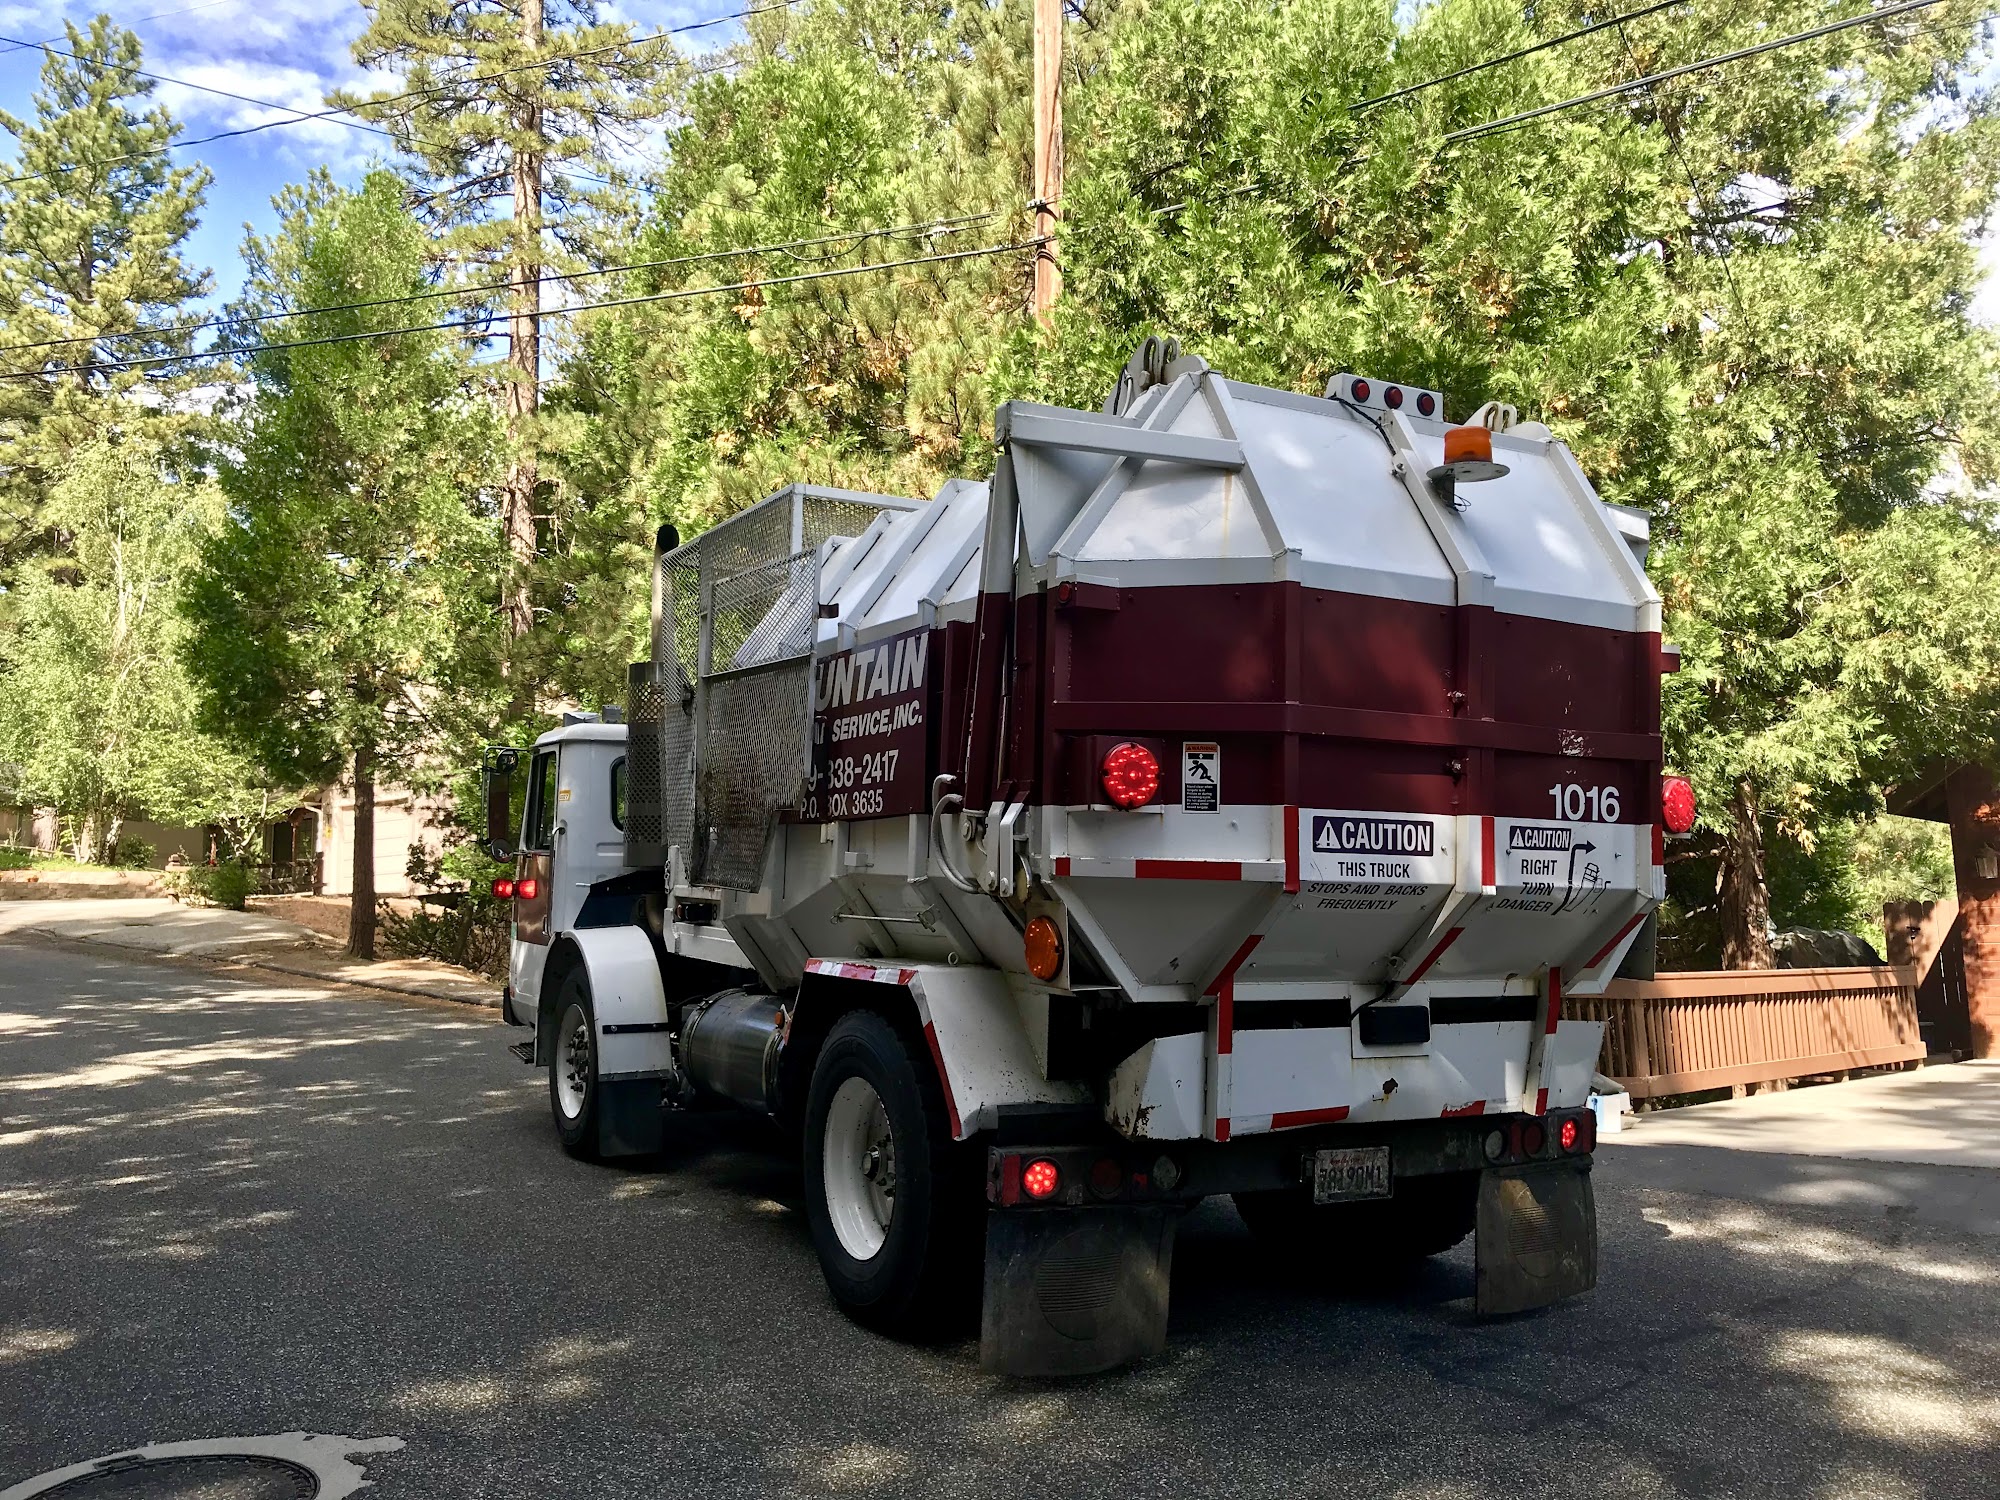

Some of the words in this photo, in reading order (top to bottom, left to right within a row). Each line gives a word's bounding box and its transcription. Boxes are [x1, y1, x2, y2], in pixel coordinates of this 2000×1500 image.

[815, 632, 929, 712] UNTAIN
[852, 788, 883, 815] 3635
[1548, 783, 1620, 823] 1016
[1341, 821, 1431, 852] CAUTION
[1524, 828, 1570, 849] CAUTION
[1338, 861, 1366, 877] THIS
[1369, 862, 1410, 878] TRUCK
[1521, 858, 1557, 875] RIGHT
[1307, 882, 1352, 894] STOPS
[1350, 884, 1380, 895] AND
[1384, 885, 1428, 896] BACKS
[1519, 881, 1555, 896] TURN
[1317, 898, 1398, 910] FREQUENTLY
[1496, 898, 1553, 912] DANGER
